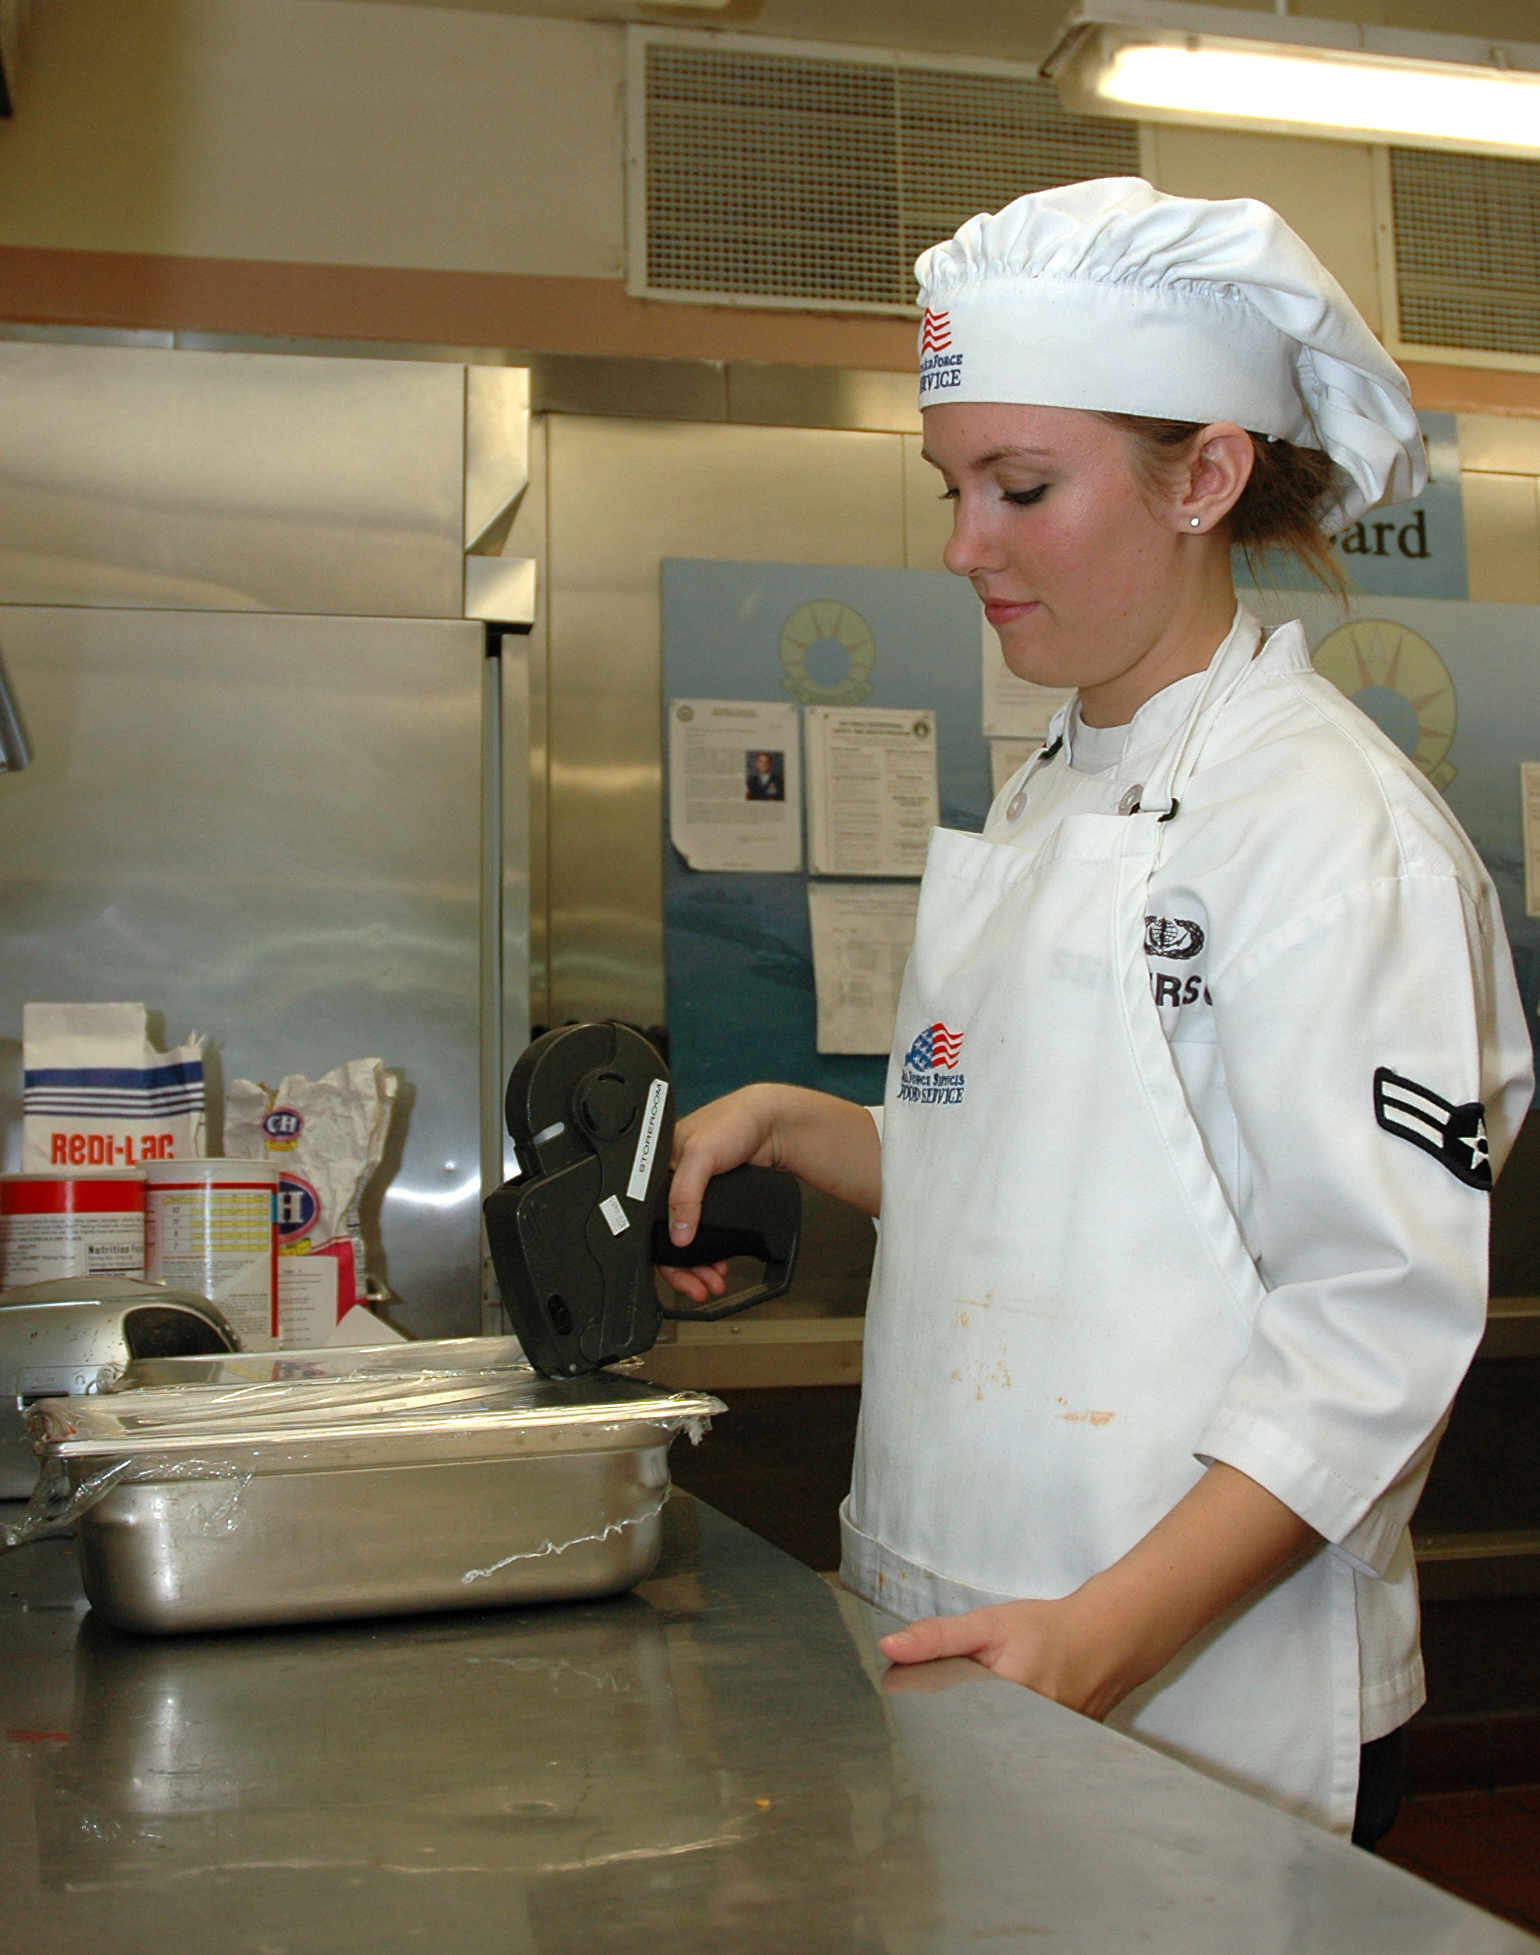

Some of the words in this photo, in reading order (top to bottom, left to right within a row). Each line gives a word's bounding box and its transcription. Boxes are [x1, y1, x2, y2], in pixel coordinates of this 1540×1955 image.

[920, 369, 961, 394] RVICE
[1330, 509, 1431, 558] ard
[1149, 972, 1213, 1008] RS
[921, 1087, 965, 1104] SERVICE
[638, 1083, 662, 1173] STOREROOM
[89, 1244, 129, 1254] Nutrition
